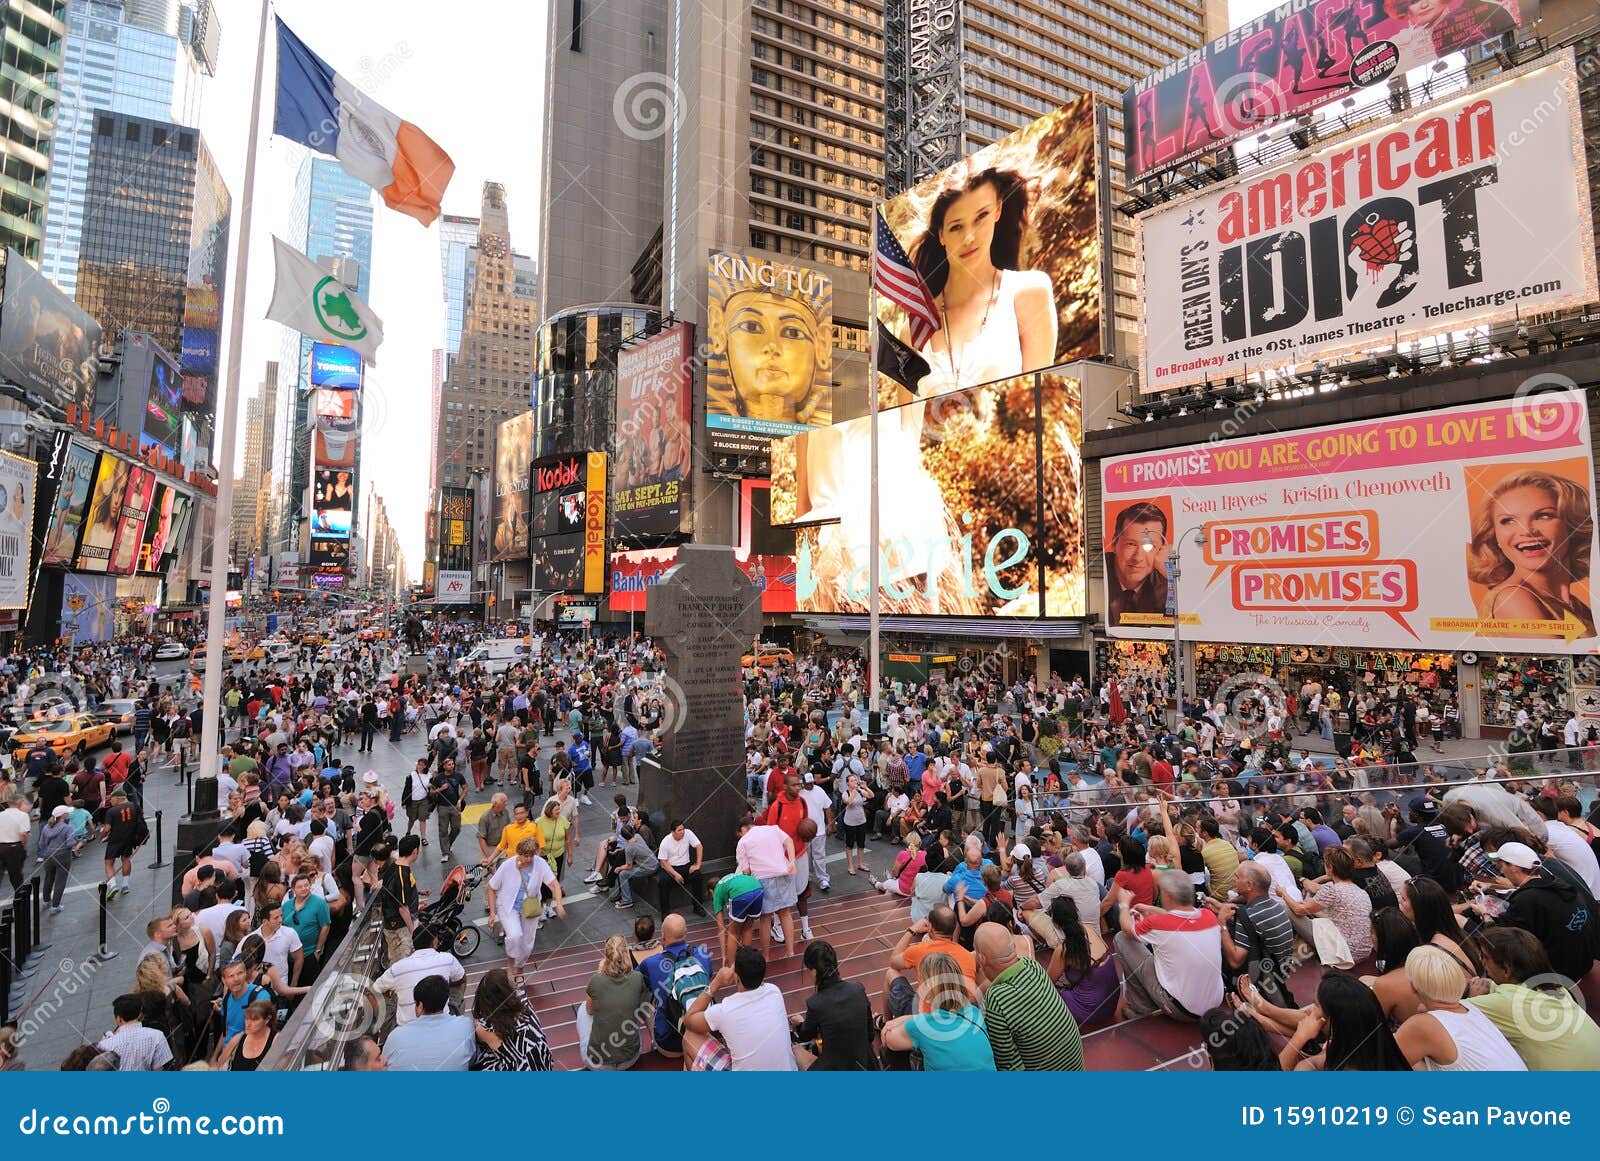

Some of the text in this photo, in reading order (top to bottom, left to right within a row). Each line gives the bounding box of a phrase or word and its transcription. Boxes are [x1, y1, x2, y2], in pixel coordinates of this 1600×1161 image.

[1134, 47, 1207, 95] WINNER!
[1214, 15, 1267, 54] BEST
[1136, 60, 1224, 173] LA
[1217, 98, 1495, 245] american
[1217, 164, 1499, 345] IDIOT
[712, 254, 830, 297] KING TUT
[1422, 279, 1562, 319] Telecharge.com
[1184, 291, 1213, 350] GREEN
[1155, 313, 1405, 378] On Broadway at the St. James Theatre
[317, 362, 357, 373] TOSHIBA
[1133, 453, 1212, 483] PROMISE
[1213, 448, 1251, 472] YOU
[1258, 442, 1299, 468] ARE
[1306, 430, 1379, 461] GOING
[1386, 425, 1417, 452] TO
[1426, 415, 1497, 446] LOVE
[537, 457, 579, 492] Kodak
[615, 480, 679, 505] SAT. SEPT. 25
[1182, 471, 1452, 513] Sean Hayes Kristin Chenoweth
[587, 490, 603, 556] Kodak
[615, 503, 627, 511] LIVE
[627, 501, 635, 510] ON
[1214, 520, 1371, 556] PROMISES,
[613, 570, 644, 593] Bank
[1244, 571, 1402, 602] PROMISES
[1249, 613, 1371, 632] The Musical Comedy
[1442, 621, 1478, 629] BROADWAY
[1220, 647, 1410, 671] GRAND SLAM
